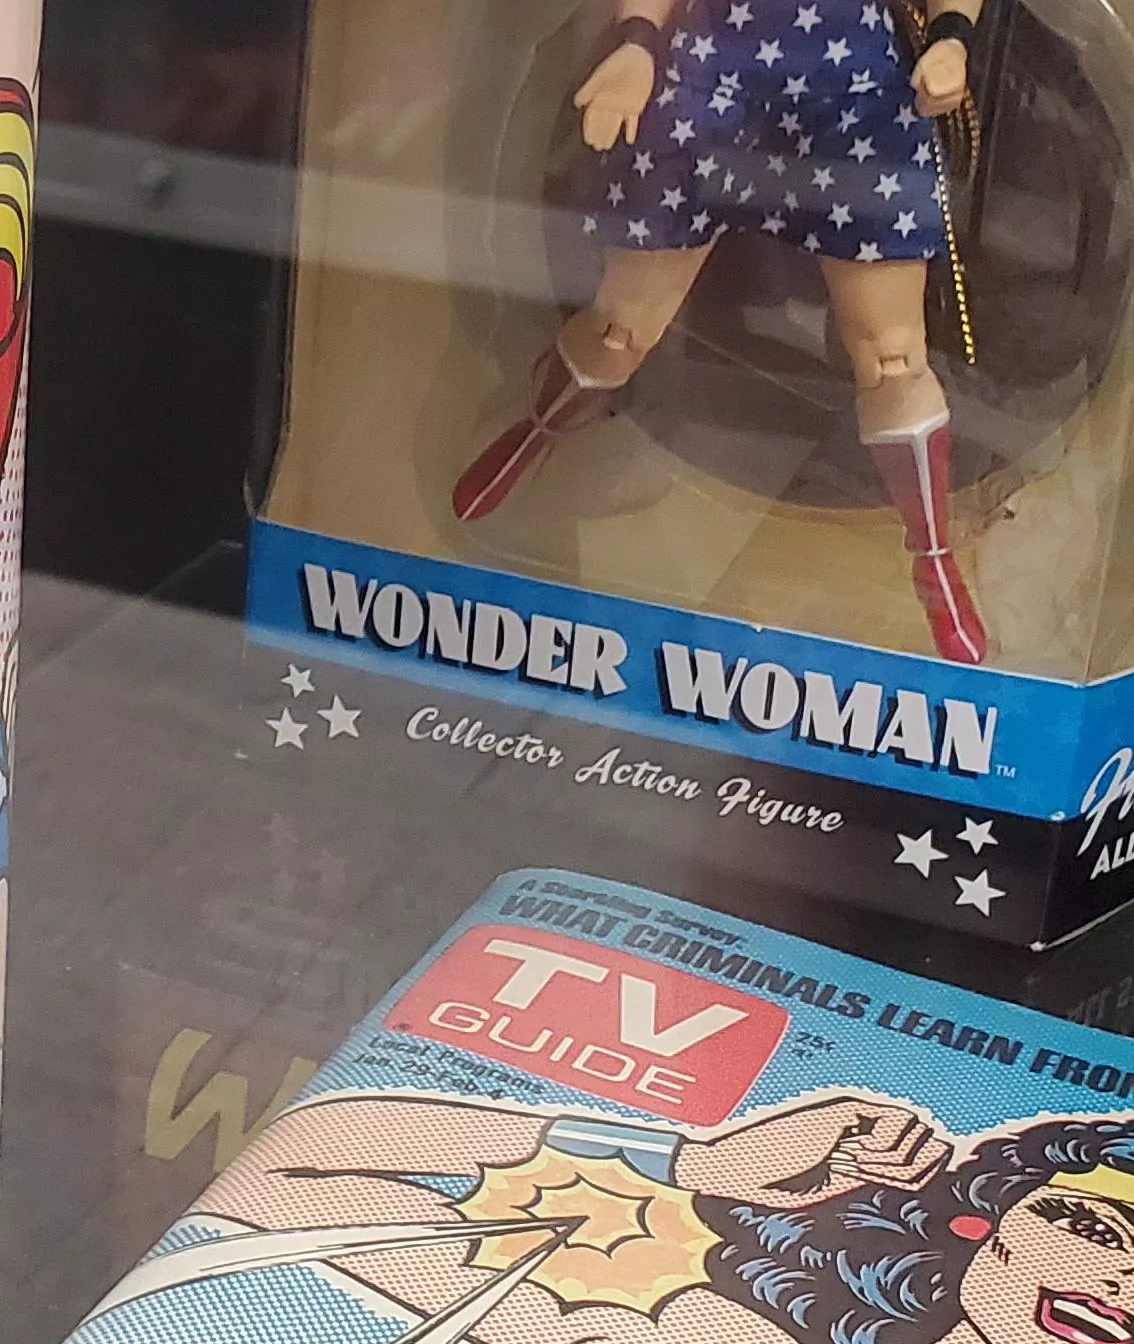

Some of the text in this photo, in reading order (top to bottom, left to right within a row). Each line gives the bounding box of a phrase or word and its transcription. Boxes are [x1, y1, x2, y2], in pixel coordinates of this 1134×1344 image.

[302, 562, 628, 696] WONDER
[661, 641, 998, 777] WOMAN
[406, 706, 845, 833] Collector Action Figure
[518, 879, 537, 892] A
[483, 938, 751, 1058] TV
[499, 894, 628, 939] WHAT
[624, 923, 871, 1020] CRIMINALS
[877, 1002, 1025, 1067] LEARN
[369, 1035, 544, 1094] Local Programs
[428, 1001, 697, 1106] GUIDE
